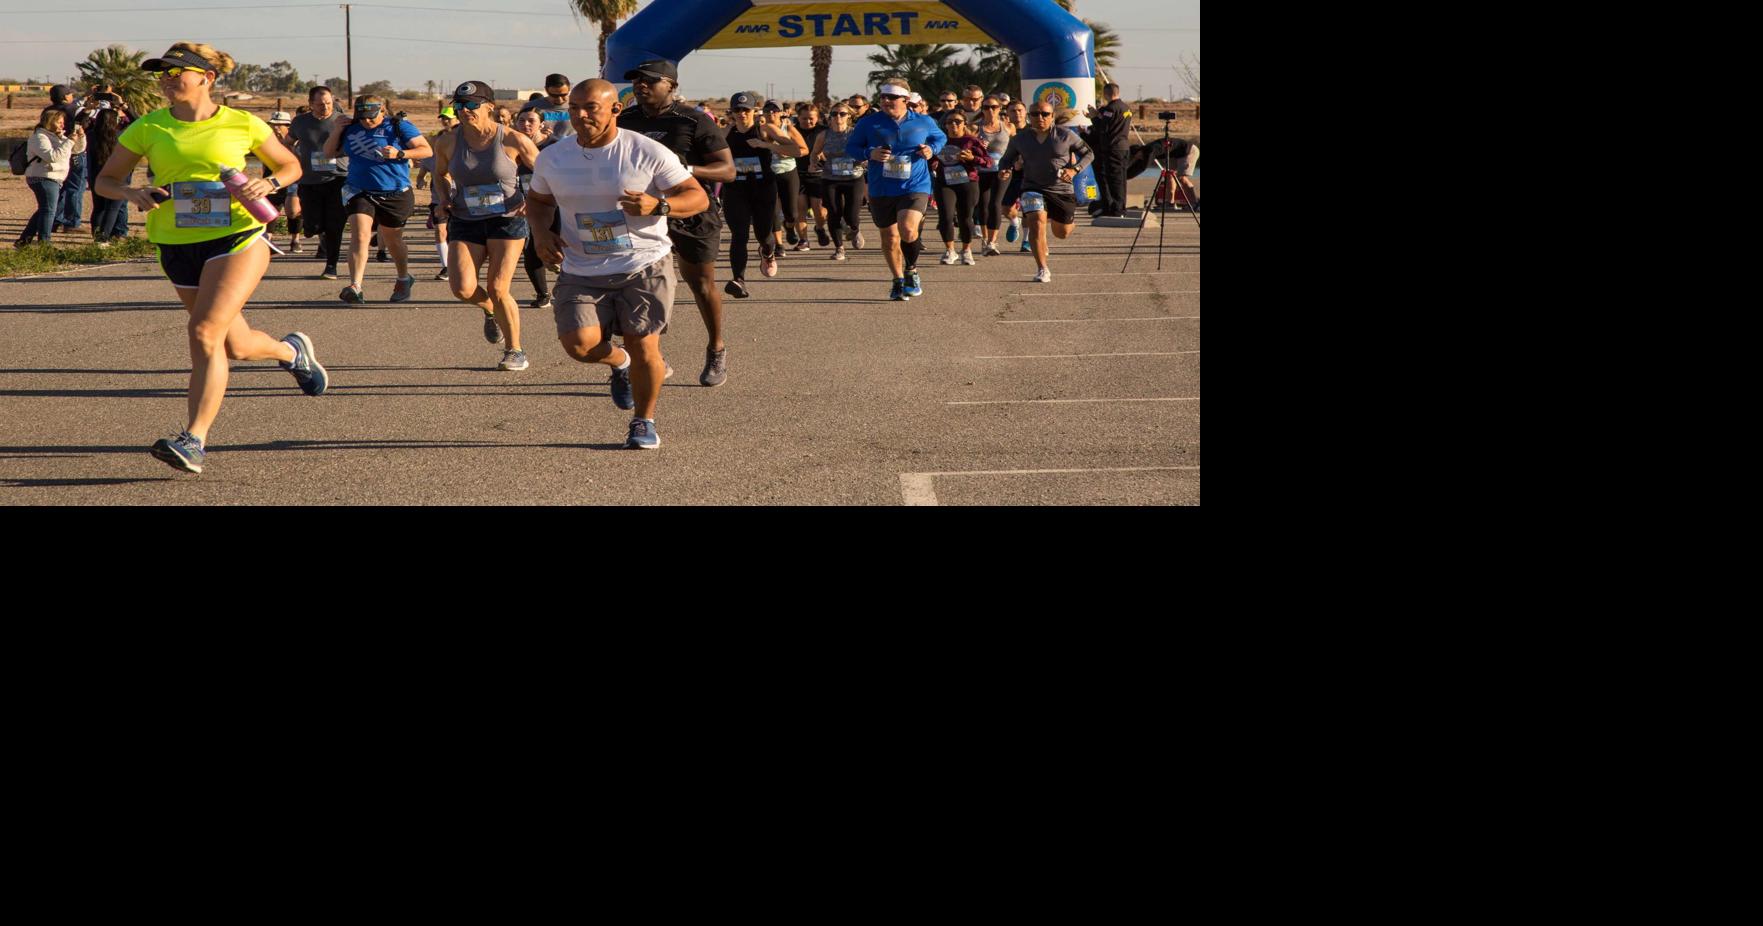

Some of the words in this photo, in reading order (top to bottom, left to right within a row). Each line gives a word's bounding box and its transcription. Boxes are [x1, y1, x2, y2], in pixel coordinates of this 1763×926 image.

[735, 24, 770, 34] MWR
[778, 12, 918, 39] START
[924, 20, 960, 30] MWR
[191, 198, 212, 214] 39
[591, 225, 615, 242] 131
